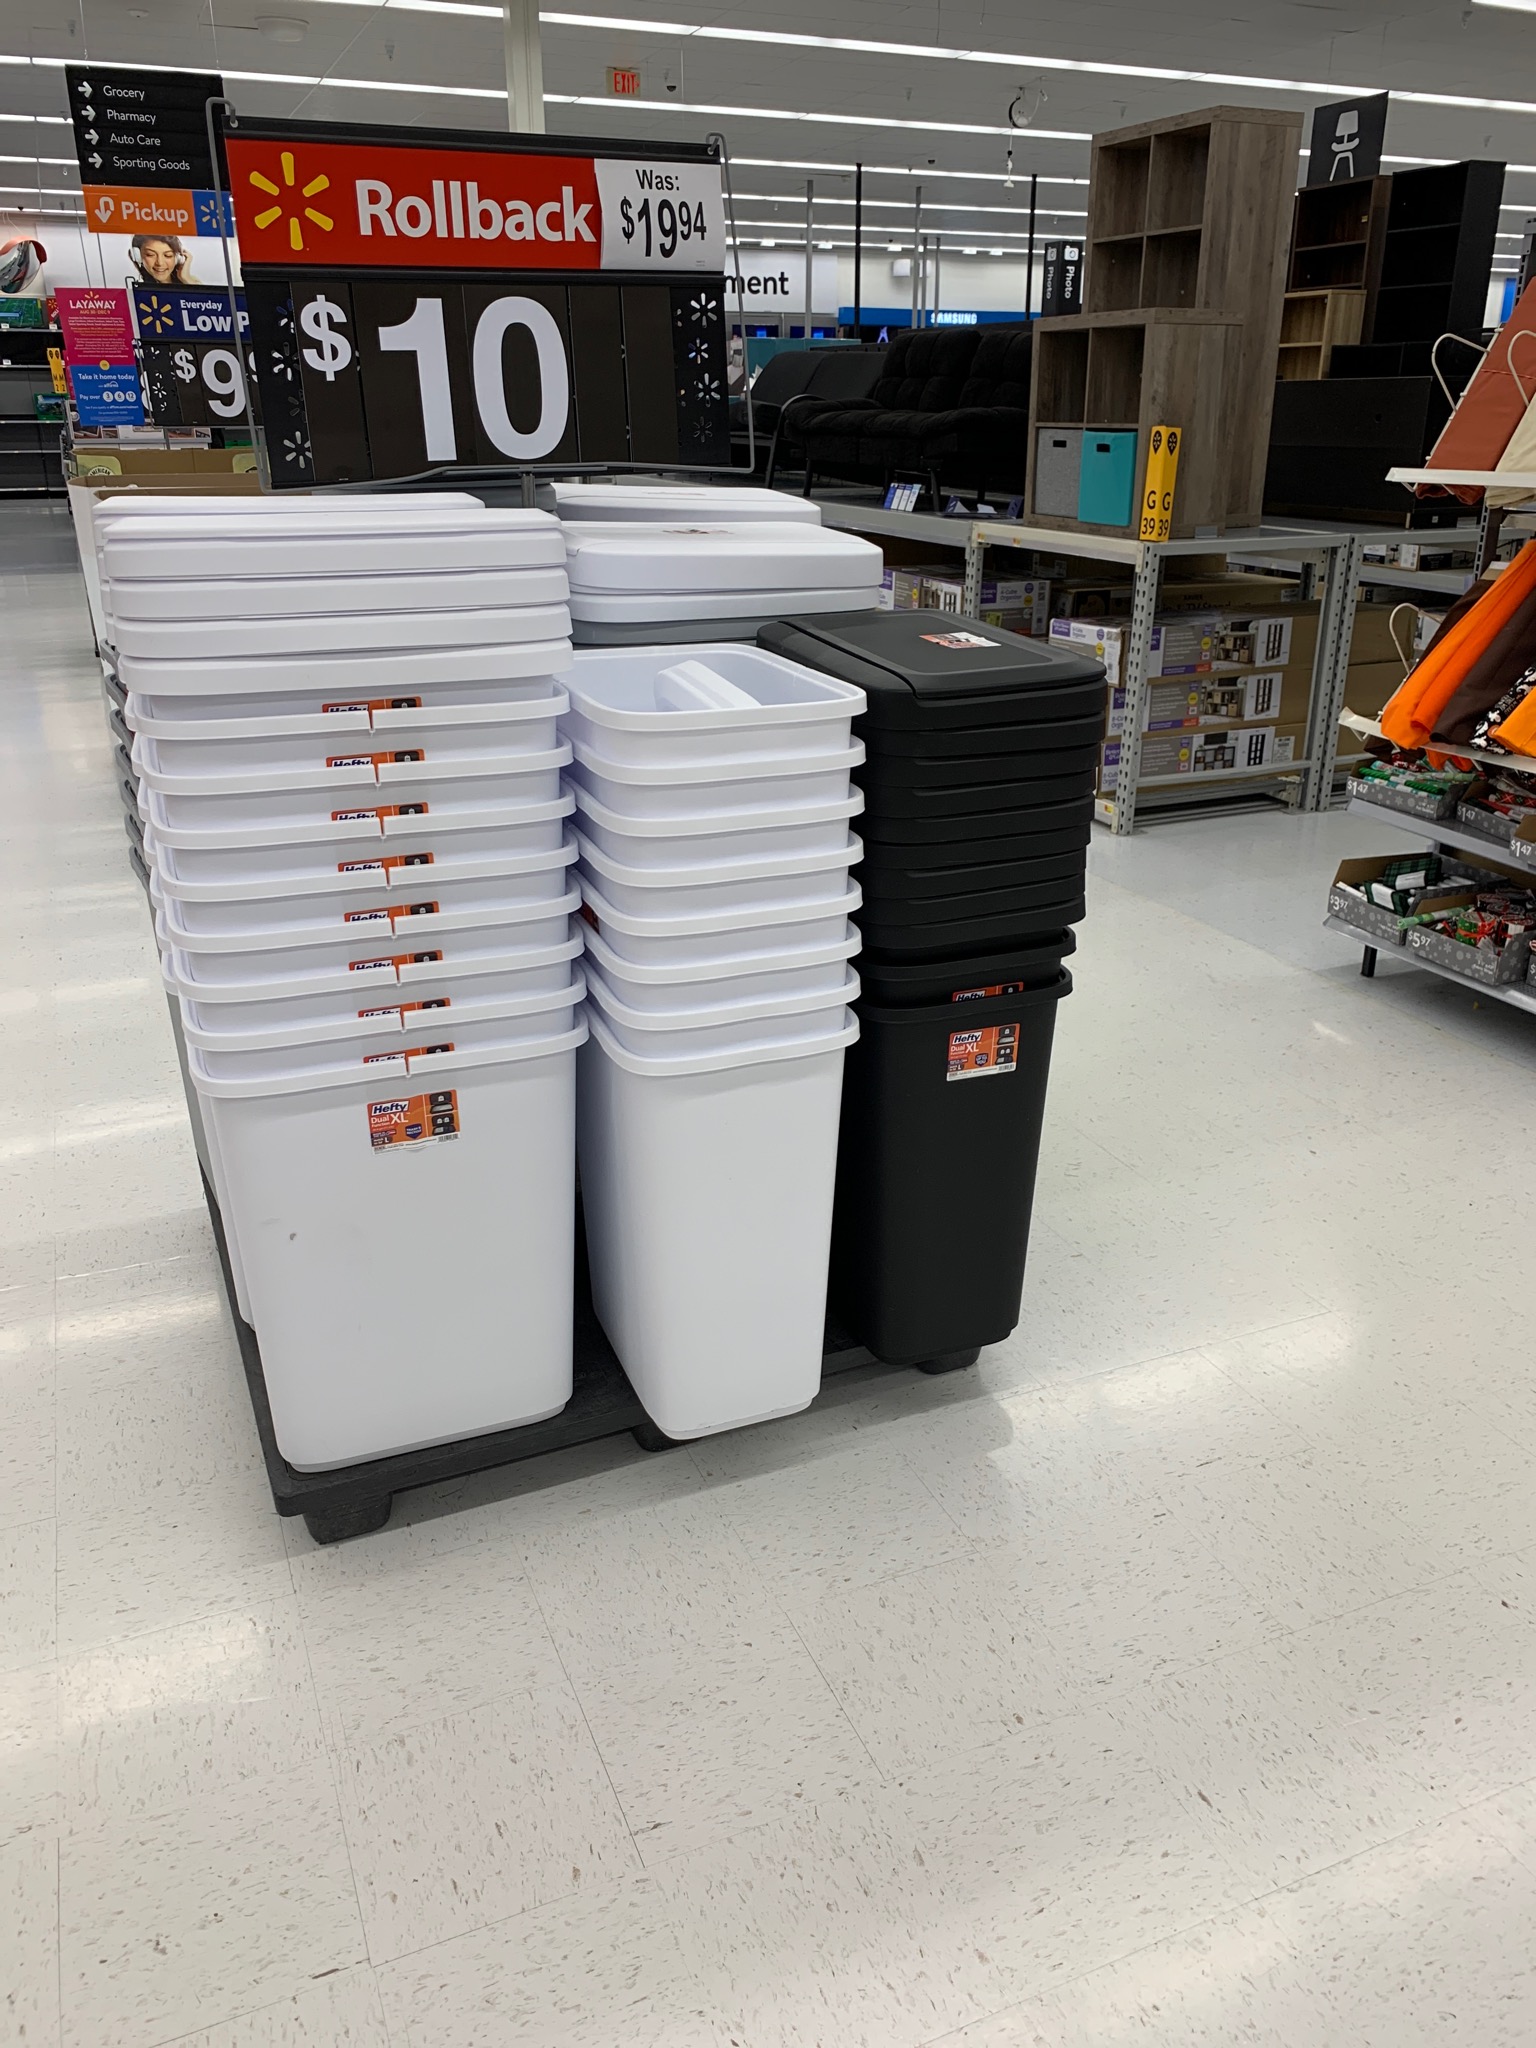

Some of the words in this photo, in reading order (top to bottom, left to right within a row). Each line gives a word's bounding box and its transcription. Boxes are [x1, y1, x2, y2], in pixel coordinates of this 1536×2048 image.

[613, 71, 637, 95] EXIT
[103, 86, 145, 101] Grocery
[106, 109, 156, 125] Pharmacy
[110, 133, 135, 145] Auto
[137, 134, 161, 146] Care
[113, 156, 156, 171] Sporting
[158, 159, 191, 170] Goods
[635, 169, 680, 191] Was:
[121, 201, 189, 228] Pickup
[355, 179, 597, 243] Rollback
[1064, 265, 1076, 299] Photo
[69, 300, 117, 309] LAYAWAY
[180, 300, 222, 312] Everyday
[930, 311, 978, 325] SAMSUNG
[118, 373, 135, 381] today
[1147, 490, 1157, 510] G
[1162, 492, 1171, 511] G
[1142, 517, 1155, 535] 39
[1158, 519, 1169, 537] 39
[954, 1033, 981, 1043] Hefty
[950, 1044, 966, 1052] Dual
[966, 1043, 979, 1054] XL
[373, 1102, 407, 1114] Hefty
[371, 1115, 390, 1124] Dual
[390, 1112, 409, 1125] XL
